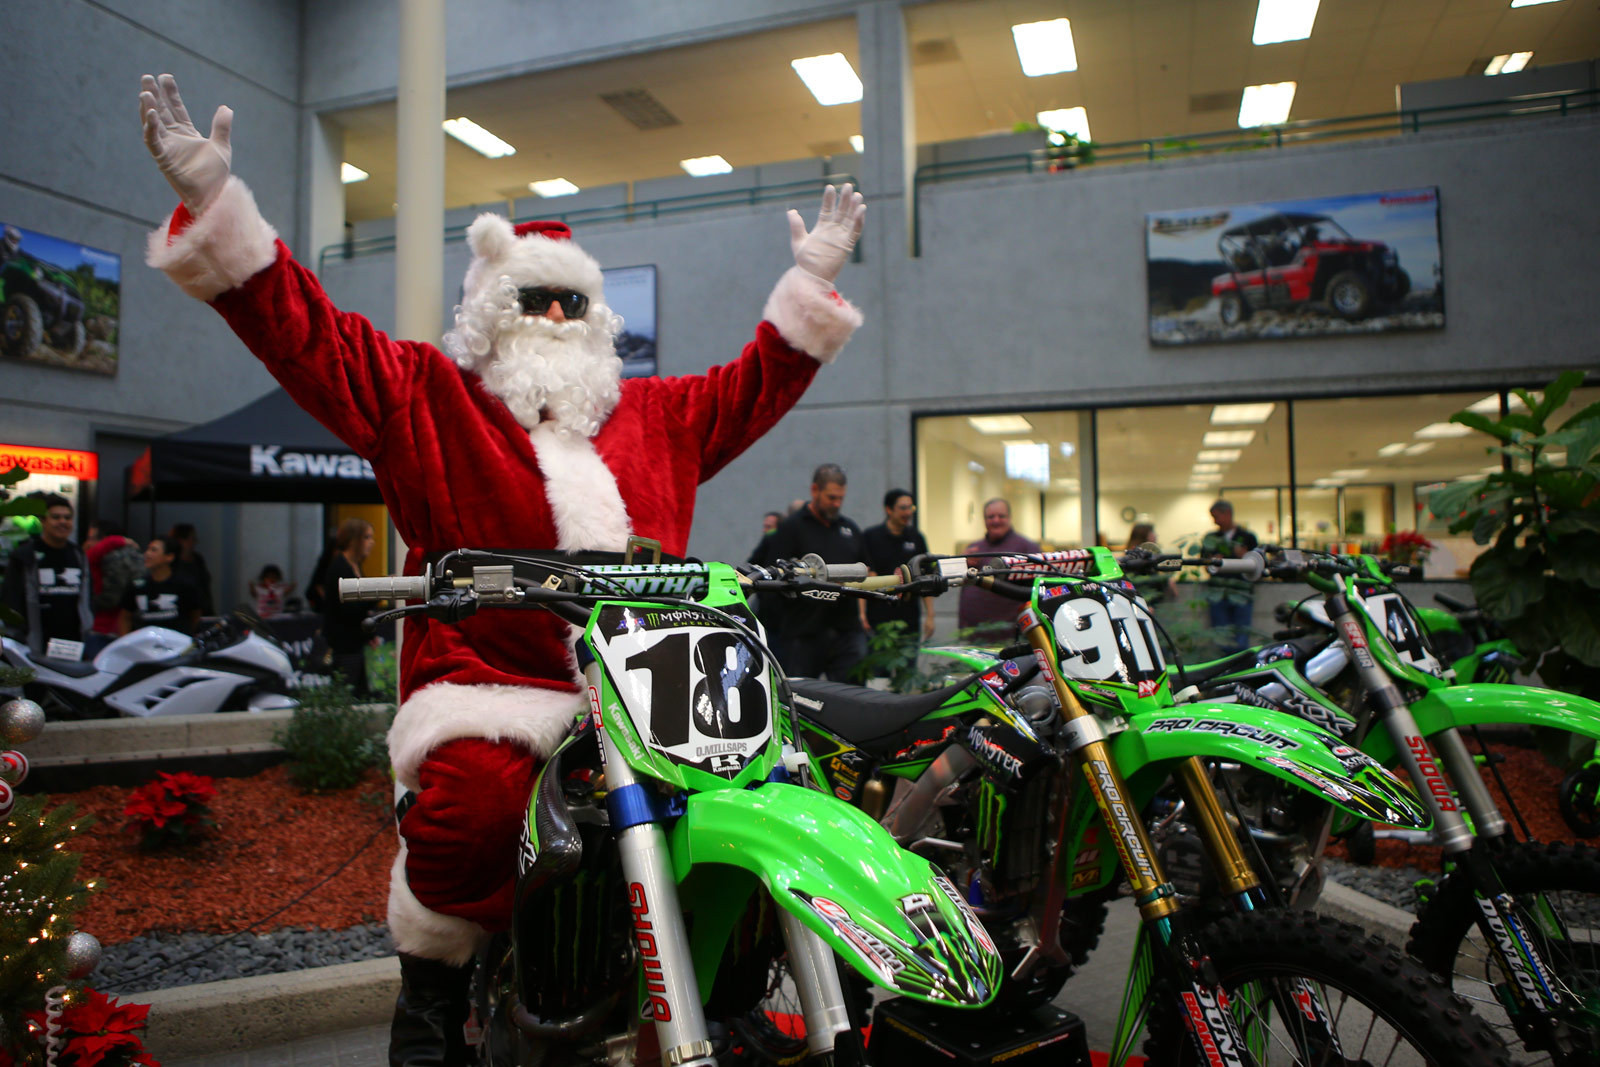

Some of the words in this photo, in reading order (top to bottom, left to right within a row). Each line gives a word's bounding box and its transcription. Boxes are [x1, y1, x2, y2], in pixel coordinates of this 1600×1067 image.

[0, 453, 84, 473] awasaki
[250, 444, 377, 480] Kawas
[582, 563, 709, 574] RENTHA
[582, 576, 708, 594] RENTHA
[801, 589, 841, 601] ARC
[1043, 585, 1071, 600] AMA
[625, 632, 770, 748] 18
[608, 702, 645, 761] Kawasaki
[1143, 717, 1194, 735] PRO
[1192, 718, 1304, 751] CIRCUIT
[696, 742, 748, 758] D.MILLSAPS
[967, 726, 1024, 780] MONSTER
[712, 764, 742, 773] Kawasaki
[1404, 735, 1457, 812] SHOWA
[1092, 759, 1121, 801] PRO
[1110, 801, 1157, 882] CIRCUIT
[626, 881, 672, 1023] SHOWA
[1475, 896, 1549, 1014] DUNLOP
[1520, 927, 1562, 1005] CARRILLO
